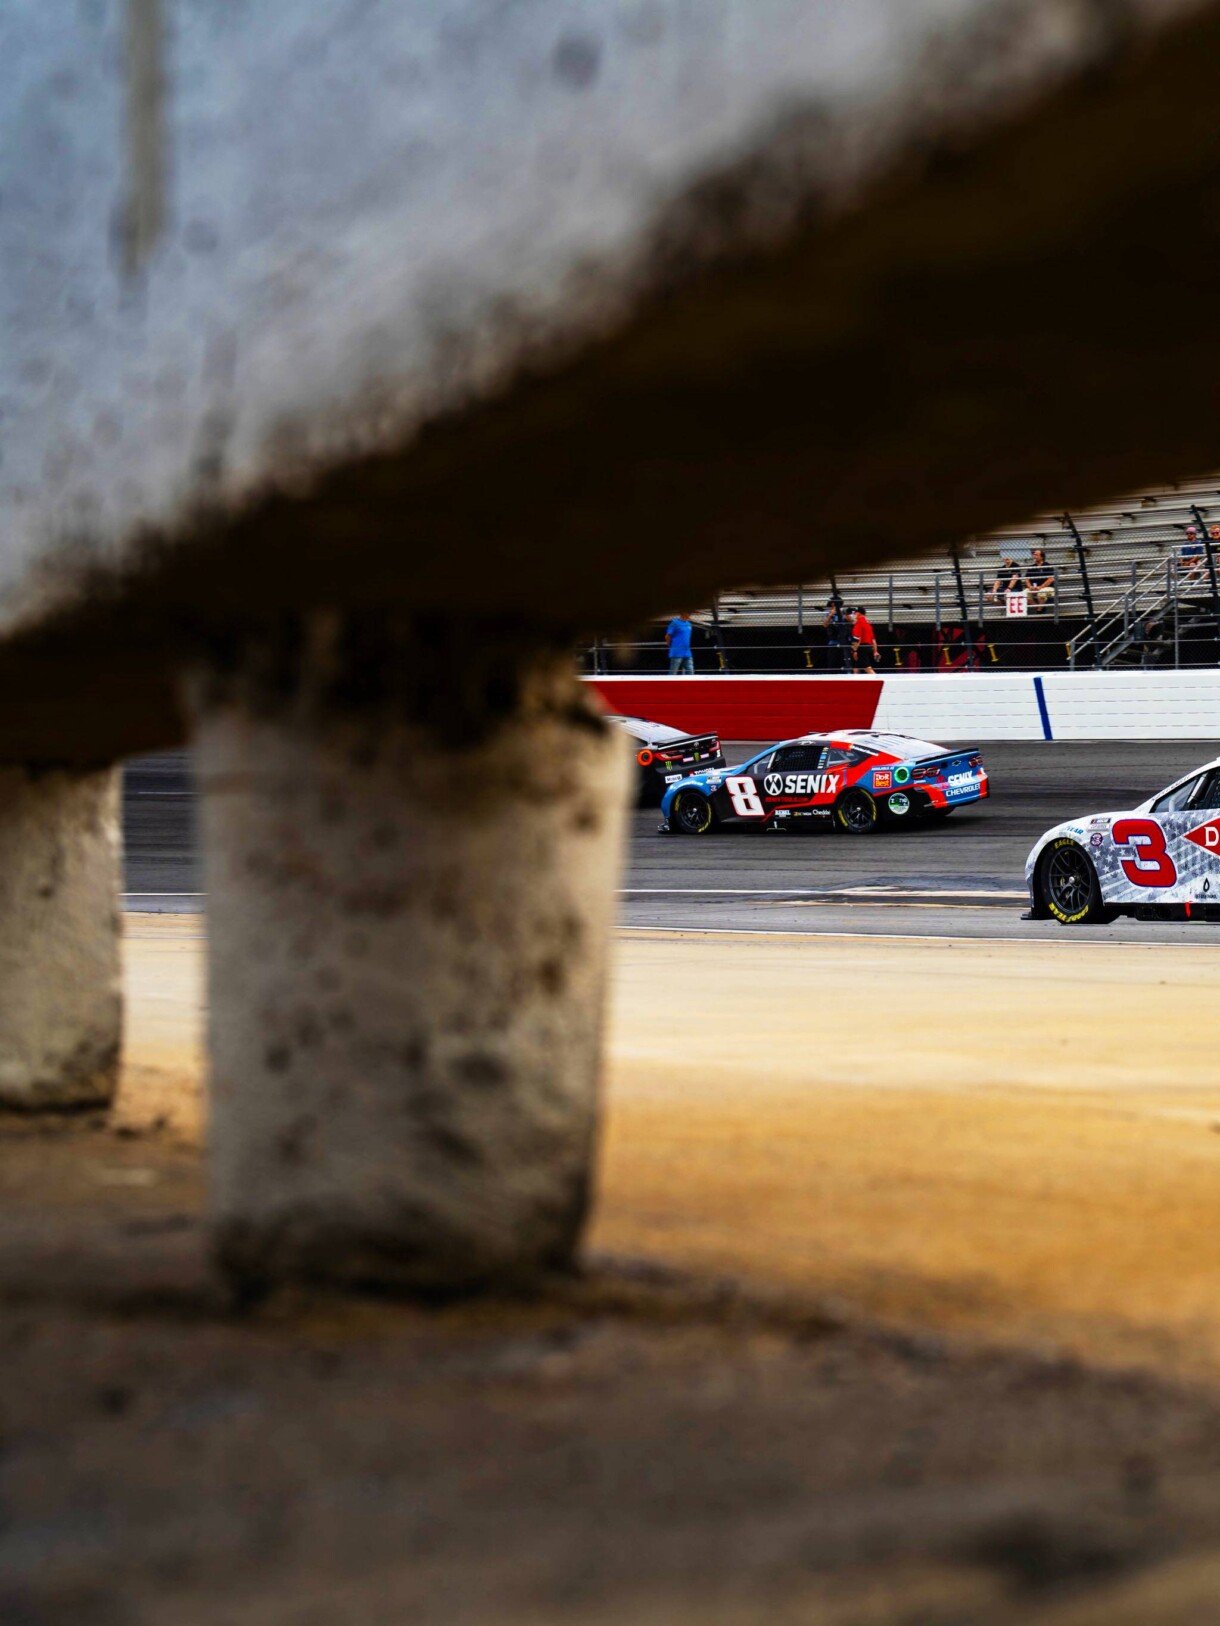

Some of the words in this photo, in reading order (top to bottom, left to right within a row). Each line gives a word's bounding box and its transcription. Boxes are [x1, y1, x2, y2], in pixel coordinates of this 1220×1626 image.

[1010, 596, 1023, 613] EE
[725, 776, 765, 816] 8
[785, 774, 840, 794] SENIX
[1112, 819, 1177, 887] 3
